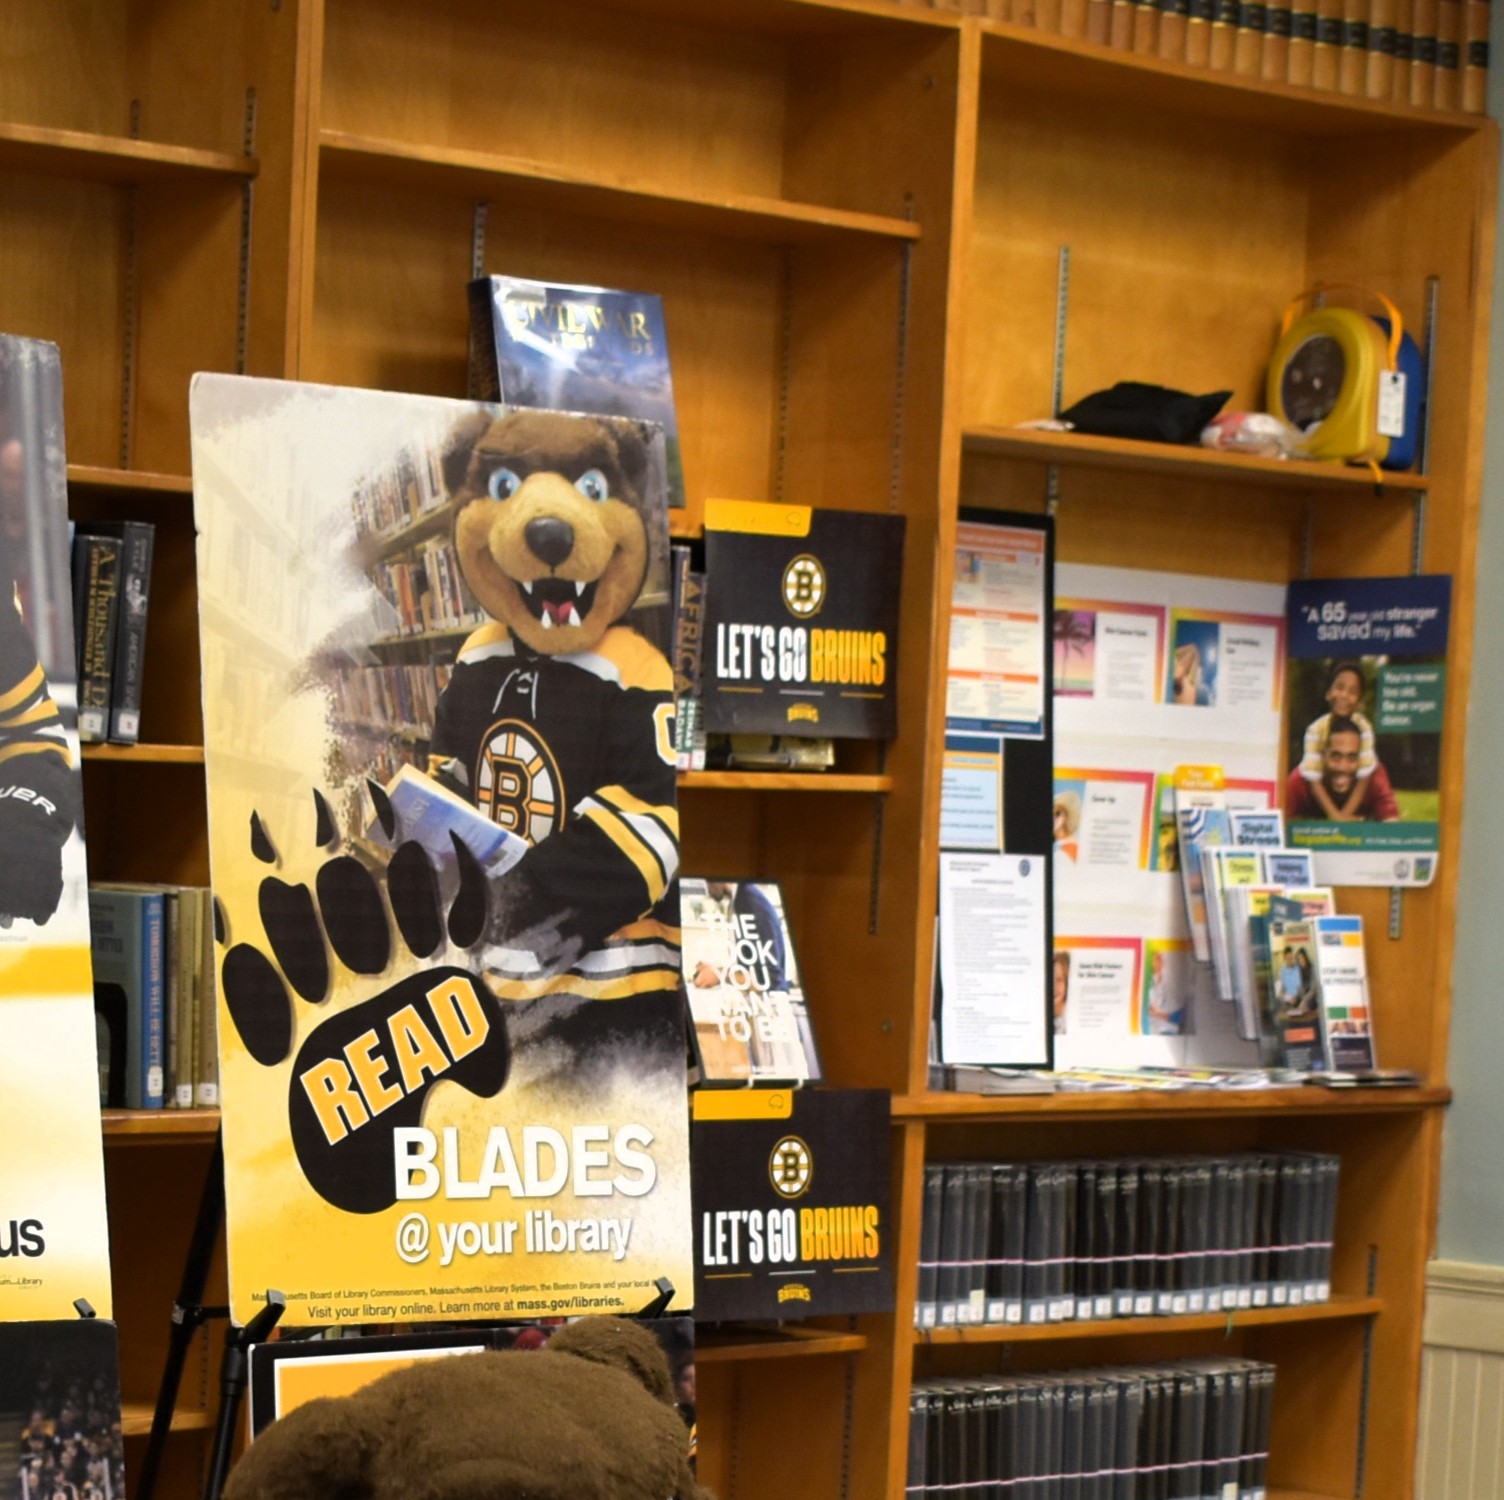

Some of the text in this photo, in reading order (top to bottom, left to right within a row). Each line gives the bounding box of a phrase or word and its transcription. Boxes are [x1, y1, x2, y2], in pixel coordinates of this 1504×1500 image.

[675, 580, 702, 692] AFRICA
[1317, 621, 1371, 641] saved
[1322, 602, 1345, 622] 65
[1386, 608, 1438, 623] stranger
[717, 623, 886, 686] LET'S GO BRUINS
[300, 975, 489, 1146] READ
[394, 1123, 658, 1199] BLADES
[396, 1209, 632, 1266] @ your library
[703, 1205, 879, 1266] LET'S GO BRUINS
[252, 1293, 308, 1301] Masusetts
[310, 1291, 332, 1300] Board
[334, 1290, 341, 1299] of
[343, 1290, 368, 1300] Library
[370, 1287, 428, 1298] Commissioners,
[430, 1285, 482, 1296] Massachusetts
[484, 1284, 508, 1296] Library
[540, 1282, 551, 1291] the
[553, 1282, 578, 1292] Boston
[580, 1281, 601, 1290] Bruins
[603, 1280, 615, 1289] and
[618, 1281, 631, 1290] your
[634, 1279, 649, 1288] local
[308, 1295, 624, 1320] Visit your library online. Learn more at mass.gov/libraries.
